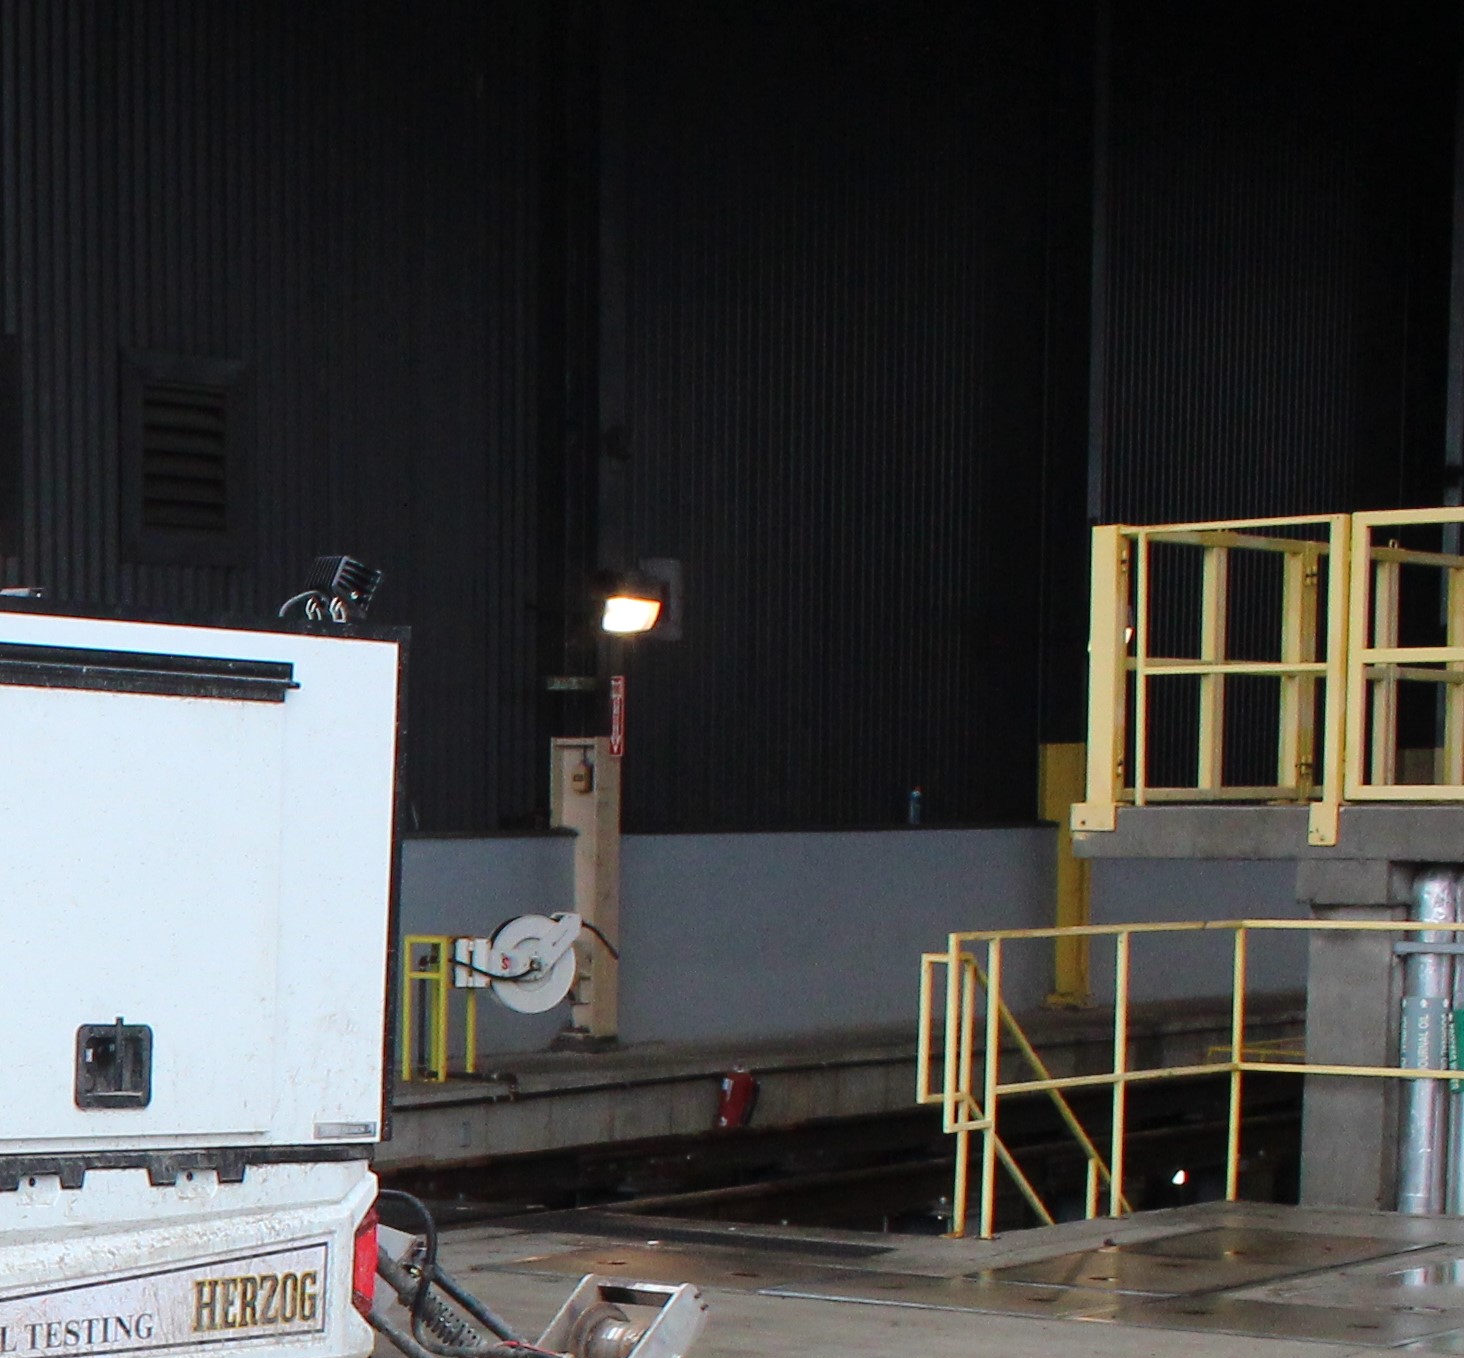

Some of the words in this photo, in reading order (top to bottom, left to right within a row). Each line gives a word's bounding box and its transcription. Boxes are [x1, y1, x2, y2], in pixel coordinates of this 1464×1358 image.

[1417, 1031, 1430, 1069] OURNAL
[24, 1312, 154, 1352] TESTING
[192, 1269, 319, 1335] HERZOG
